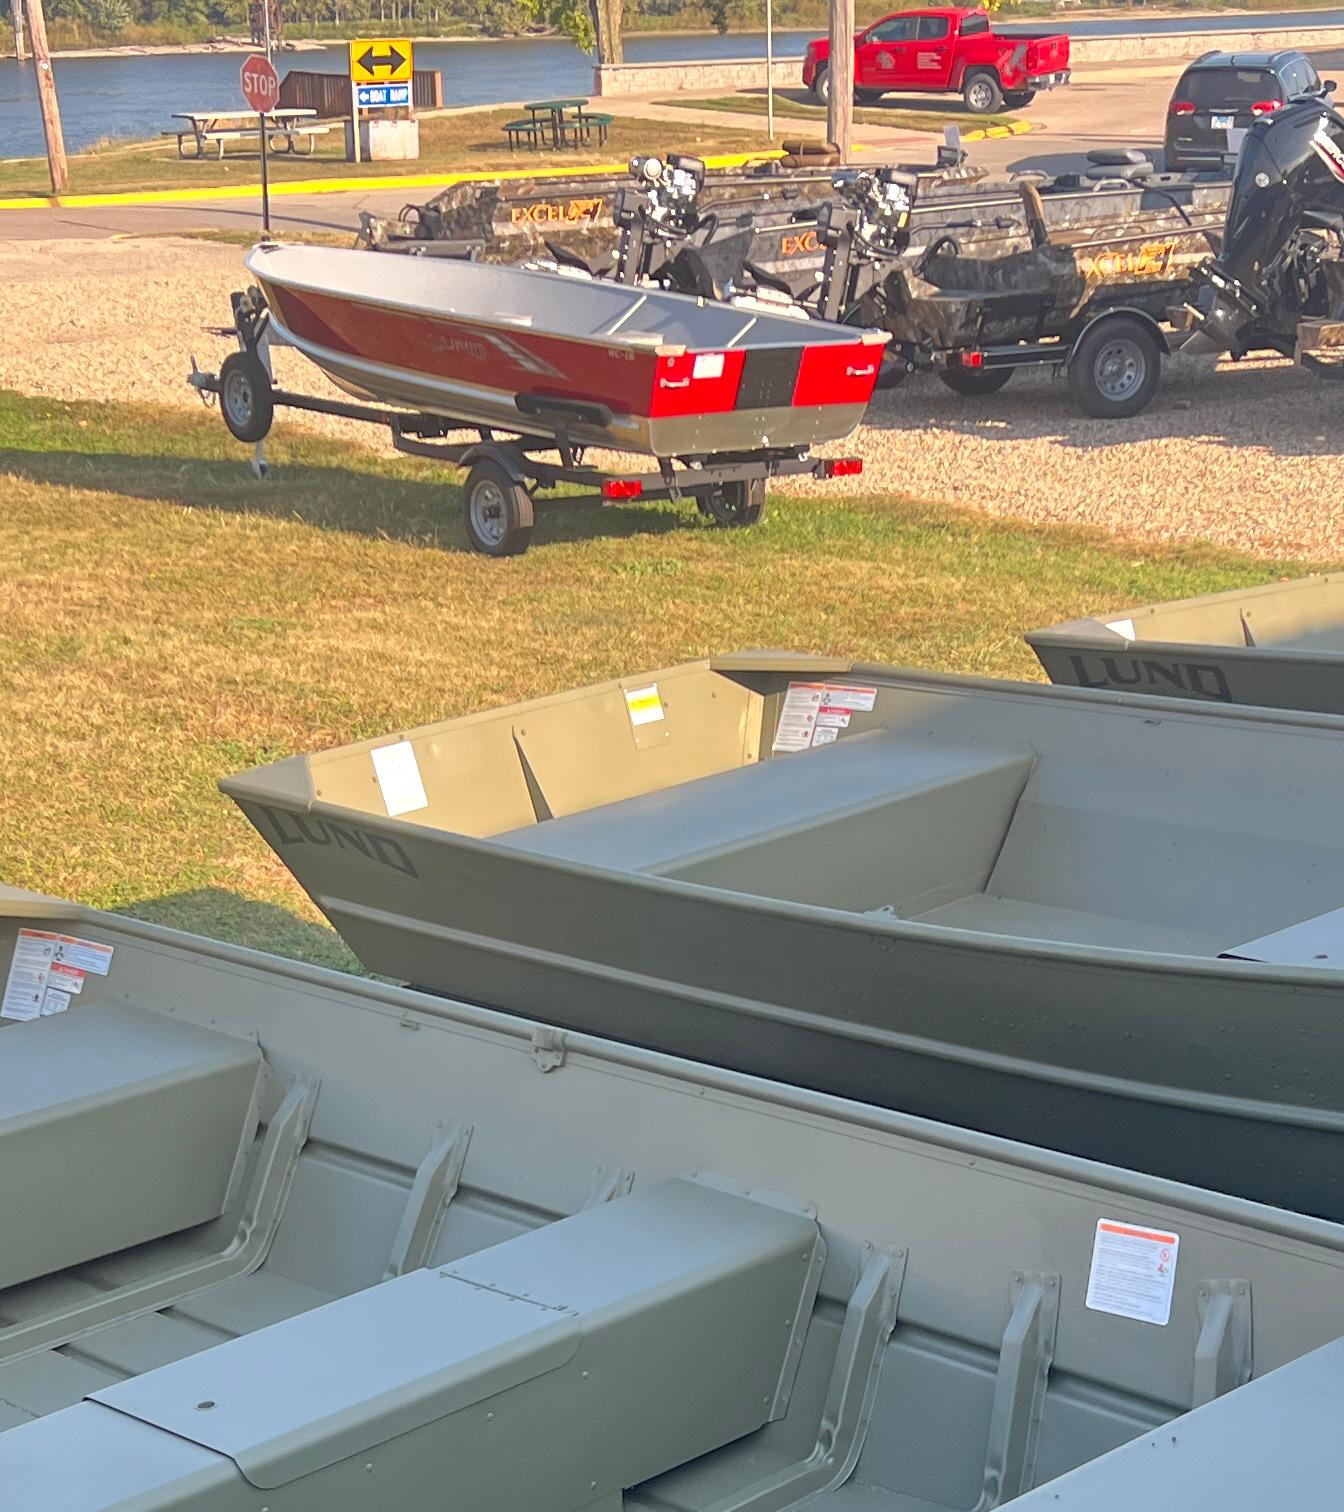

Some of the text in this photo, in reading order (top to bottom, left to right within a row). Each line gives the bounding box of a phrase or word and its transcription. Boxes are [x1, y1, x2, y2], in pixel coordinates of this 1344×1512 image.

[244, 72, 277, 97] STOP
[369, 88, 408, 103] BOAT RAMP
[511, 204, 566, 225] EXCEL
[781, 231, 829, 256] EXC
[1069, 655, 1234, 703] LUND
[258, 805, 419, 879] LUND
